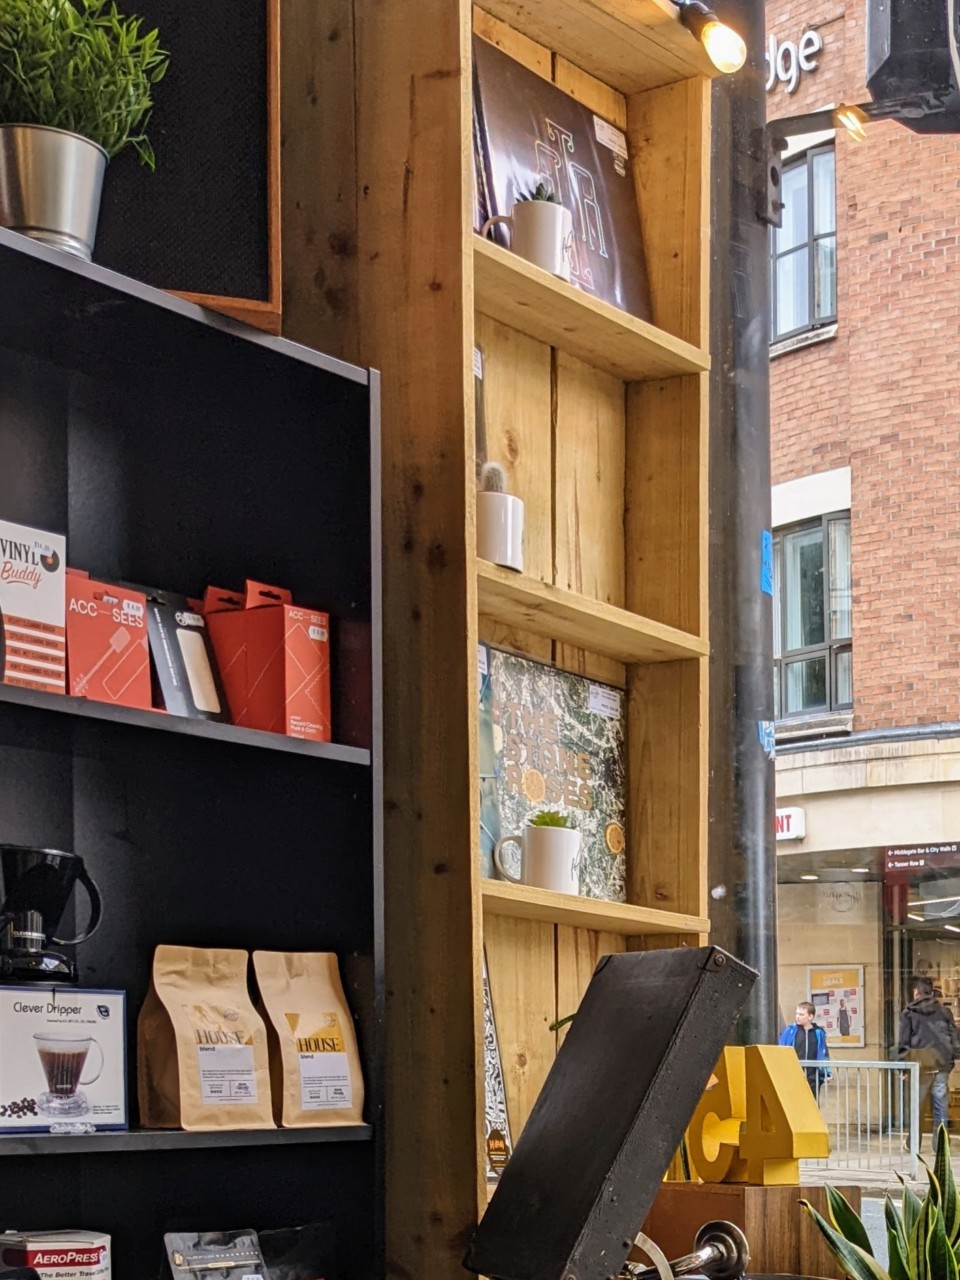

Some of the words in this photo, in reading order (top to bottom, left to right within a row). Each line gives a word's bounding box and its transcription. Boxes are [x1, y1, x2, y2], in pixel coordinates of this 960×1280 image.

[0, 538, 39, 566] VINYL
[1, 561, 42, 589] Buddy
[69, 598, 97, 616] ACC
[113, 609, 144, 627] SEES
[288, 610, 303, 620] ACC
[310, 615, 327, 625] SEES
[506, 735, 593, 780] STONE
[14, 1002, 43, 1013] Clever
[47, 1002, 82, 1016] Dripper
[197, 1029, 245, 1044] HOUSE
[299, 1037, 340, 1052] HOUSE
